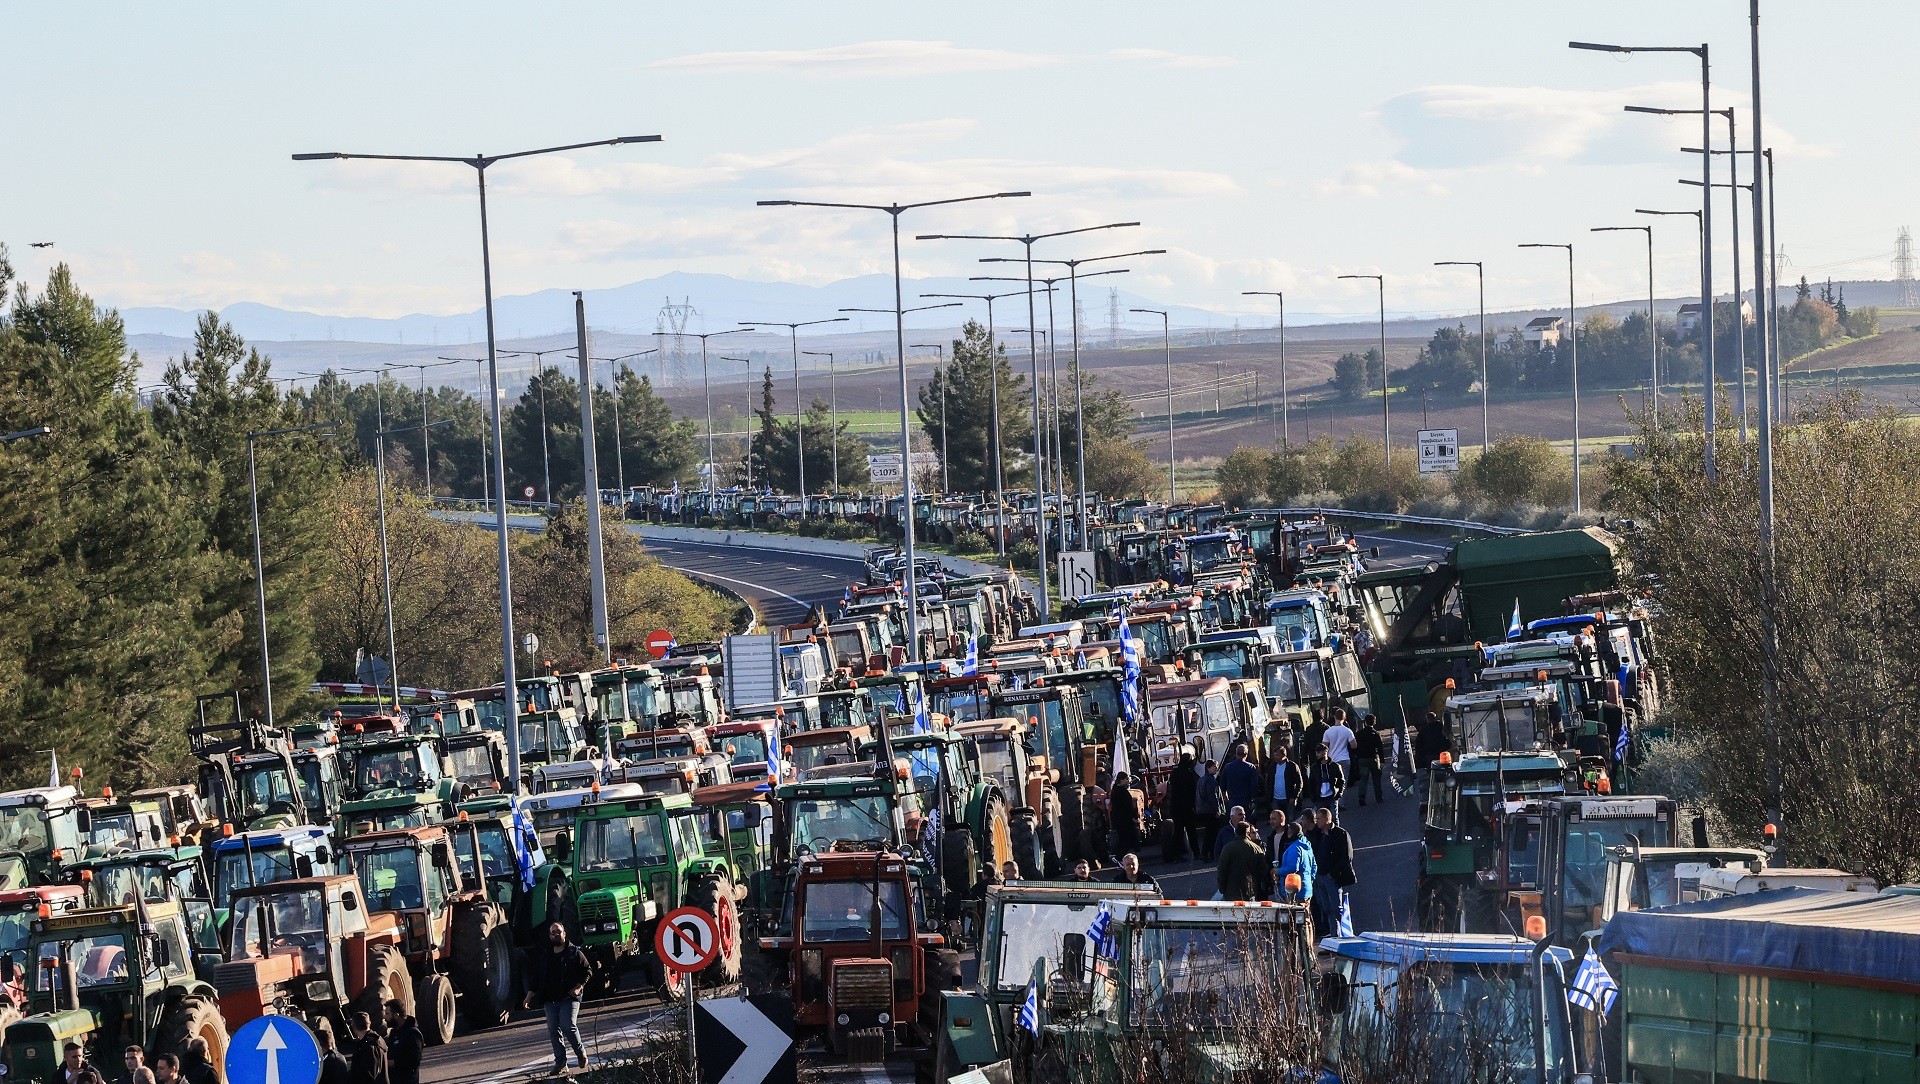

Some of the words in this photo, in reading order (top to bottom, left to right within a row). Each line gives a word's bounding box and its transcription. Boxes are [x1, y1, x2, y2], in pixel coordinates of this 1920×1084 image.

[1588, 805, 1636, 814] RENAULT
[57, 918, 77, 927] JOHN
[80, 915, 107, 924] DEERE
